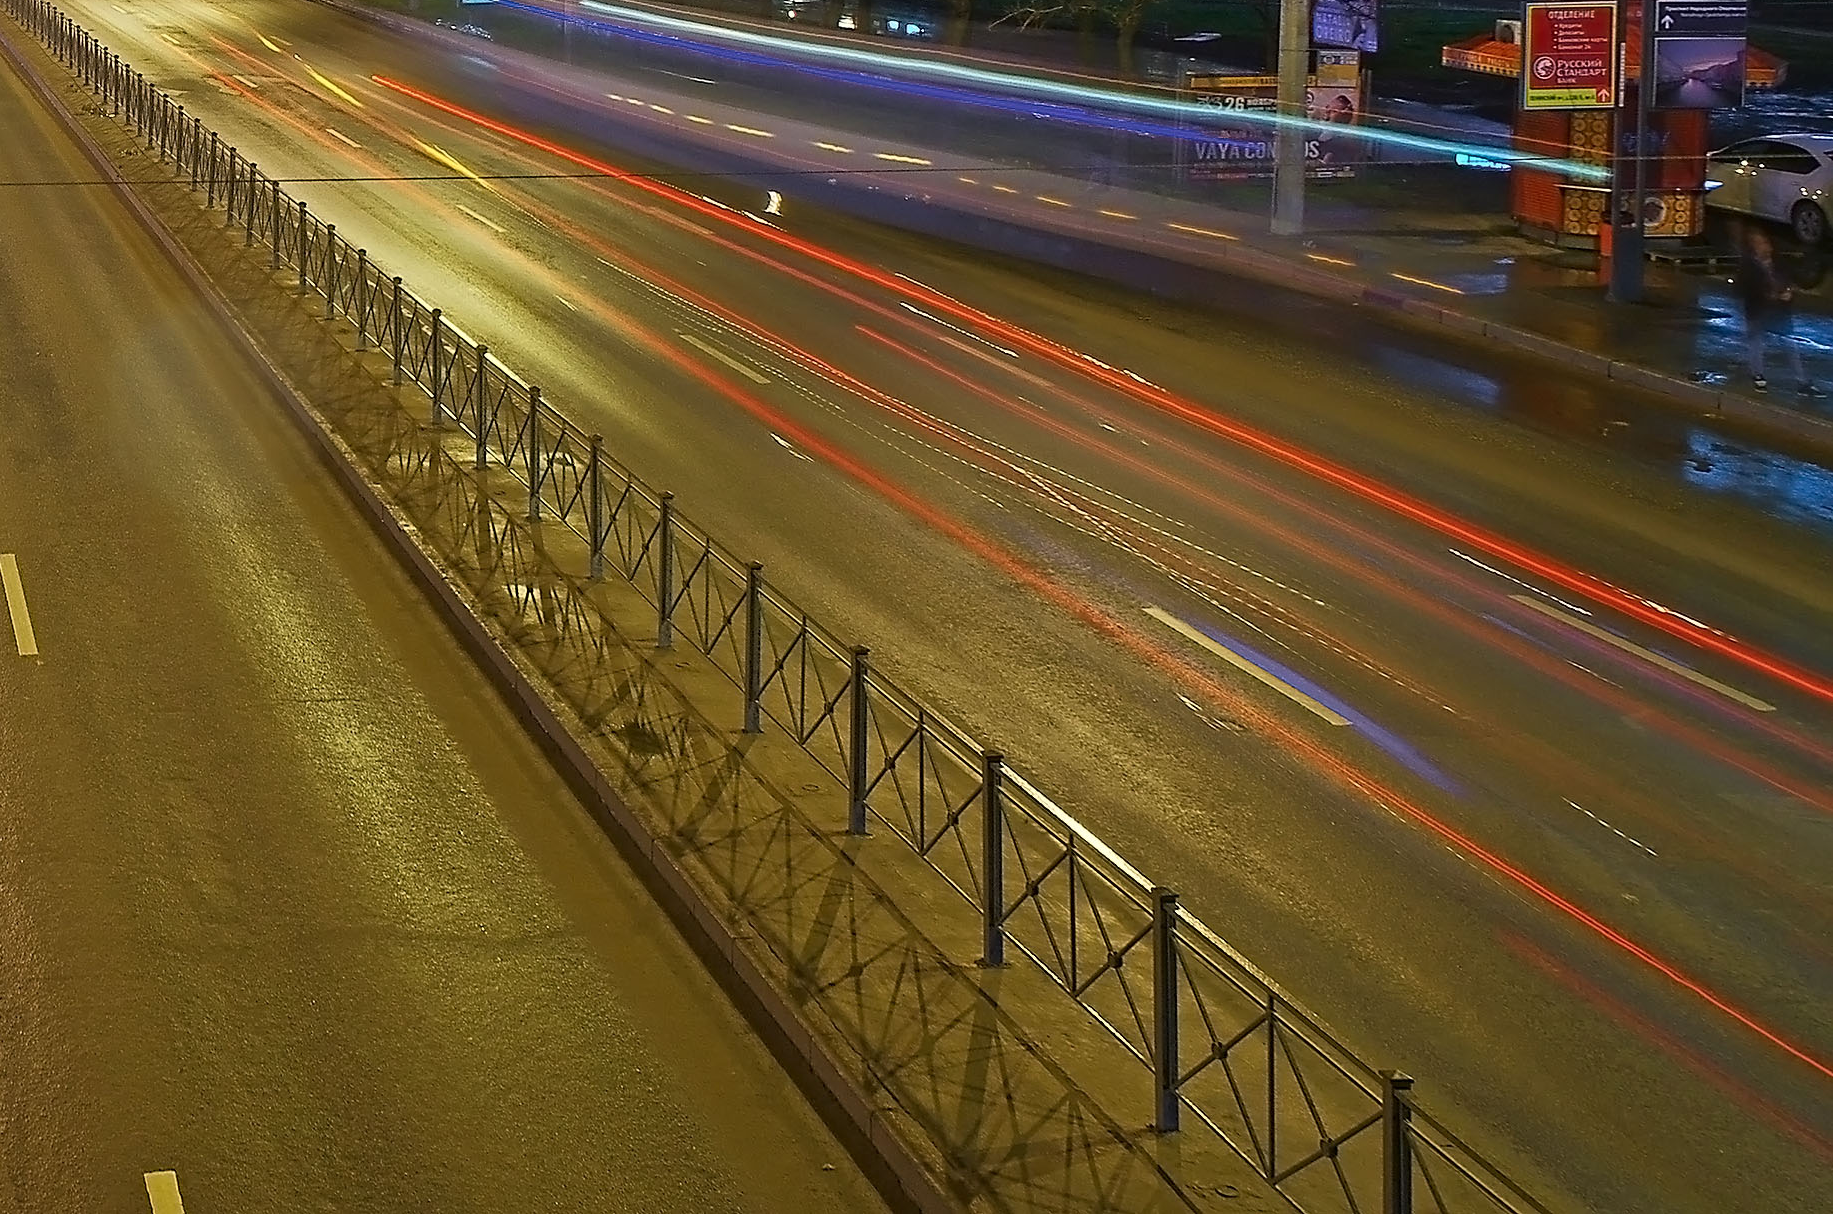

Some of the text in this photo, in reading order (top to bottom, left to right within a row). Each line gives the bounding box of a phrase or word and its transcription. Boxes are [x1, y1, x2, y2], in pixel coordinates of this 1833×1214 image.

[1548, 10, 1595, 19] ОТДЕЛЕНИЕ
[1557, 58, 1602, 69] РУССКИЙ
[1556, 68, 1608, 77] СТАНДАРТ
[1225, 97, 1245, 112] 26
[1195, 142, 1240, 160] VAYA
